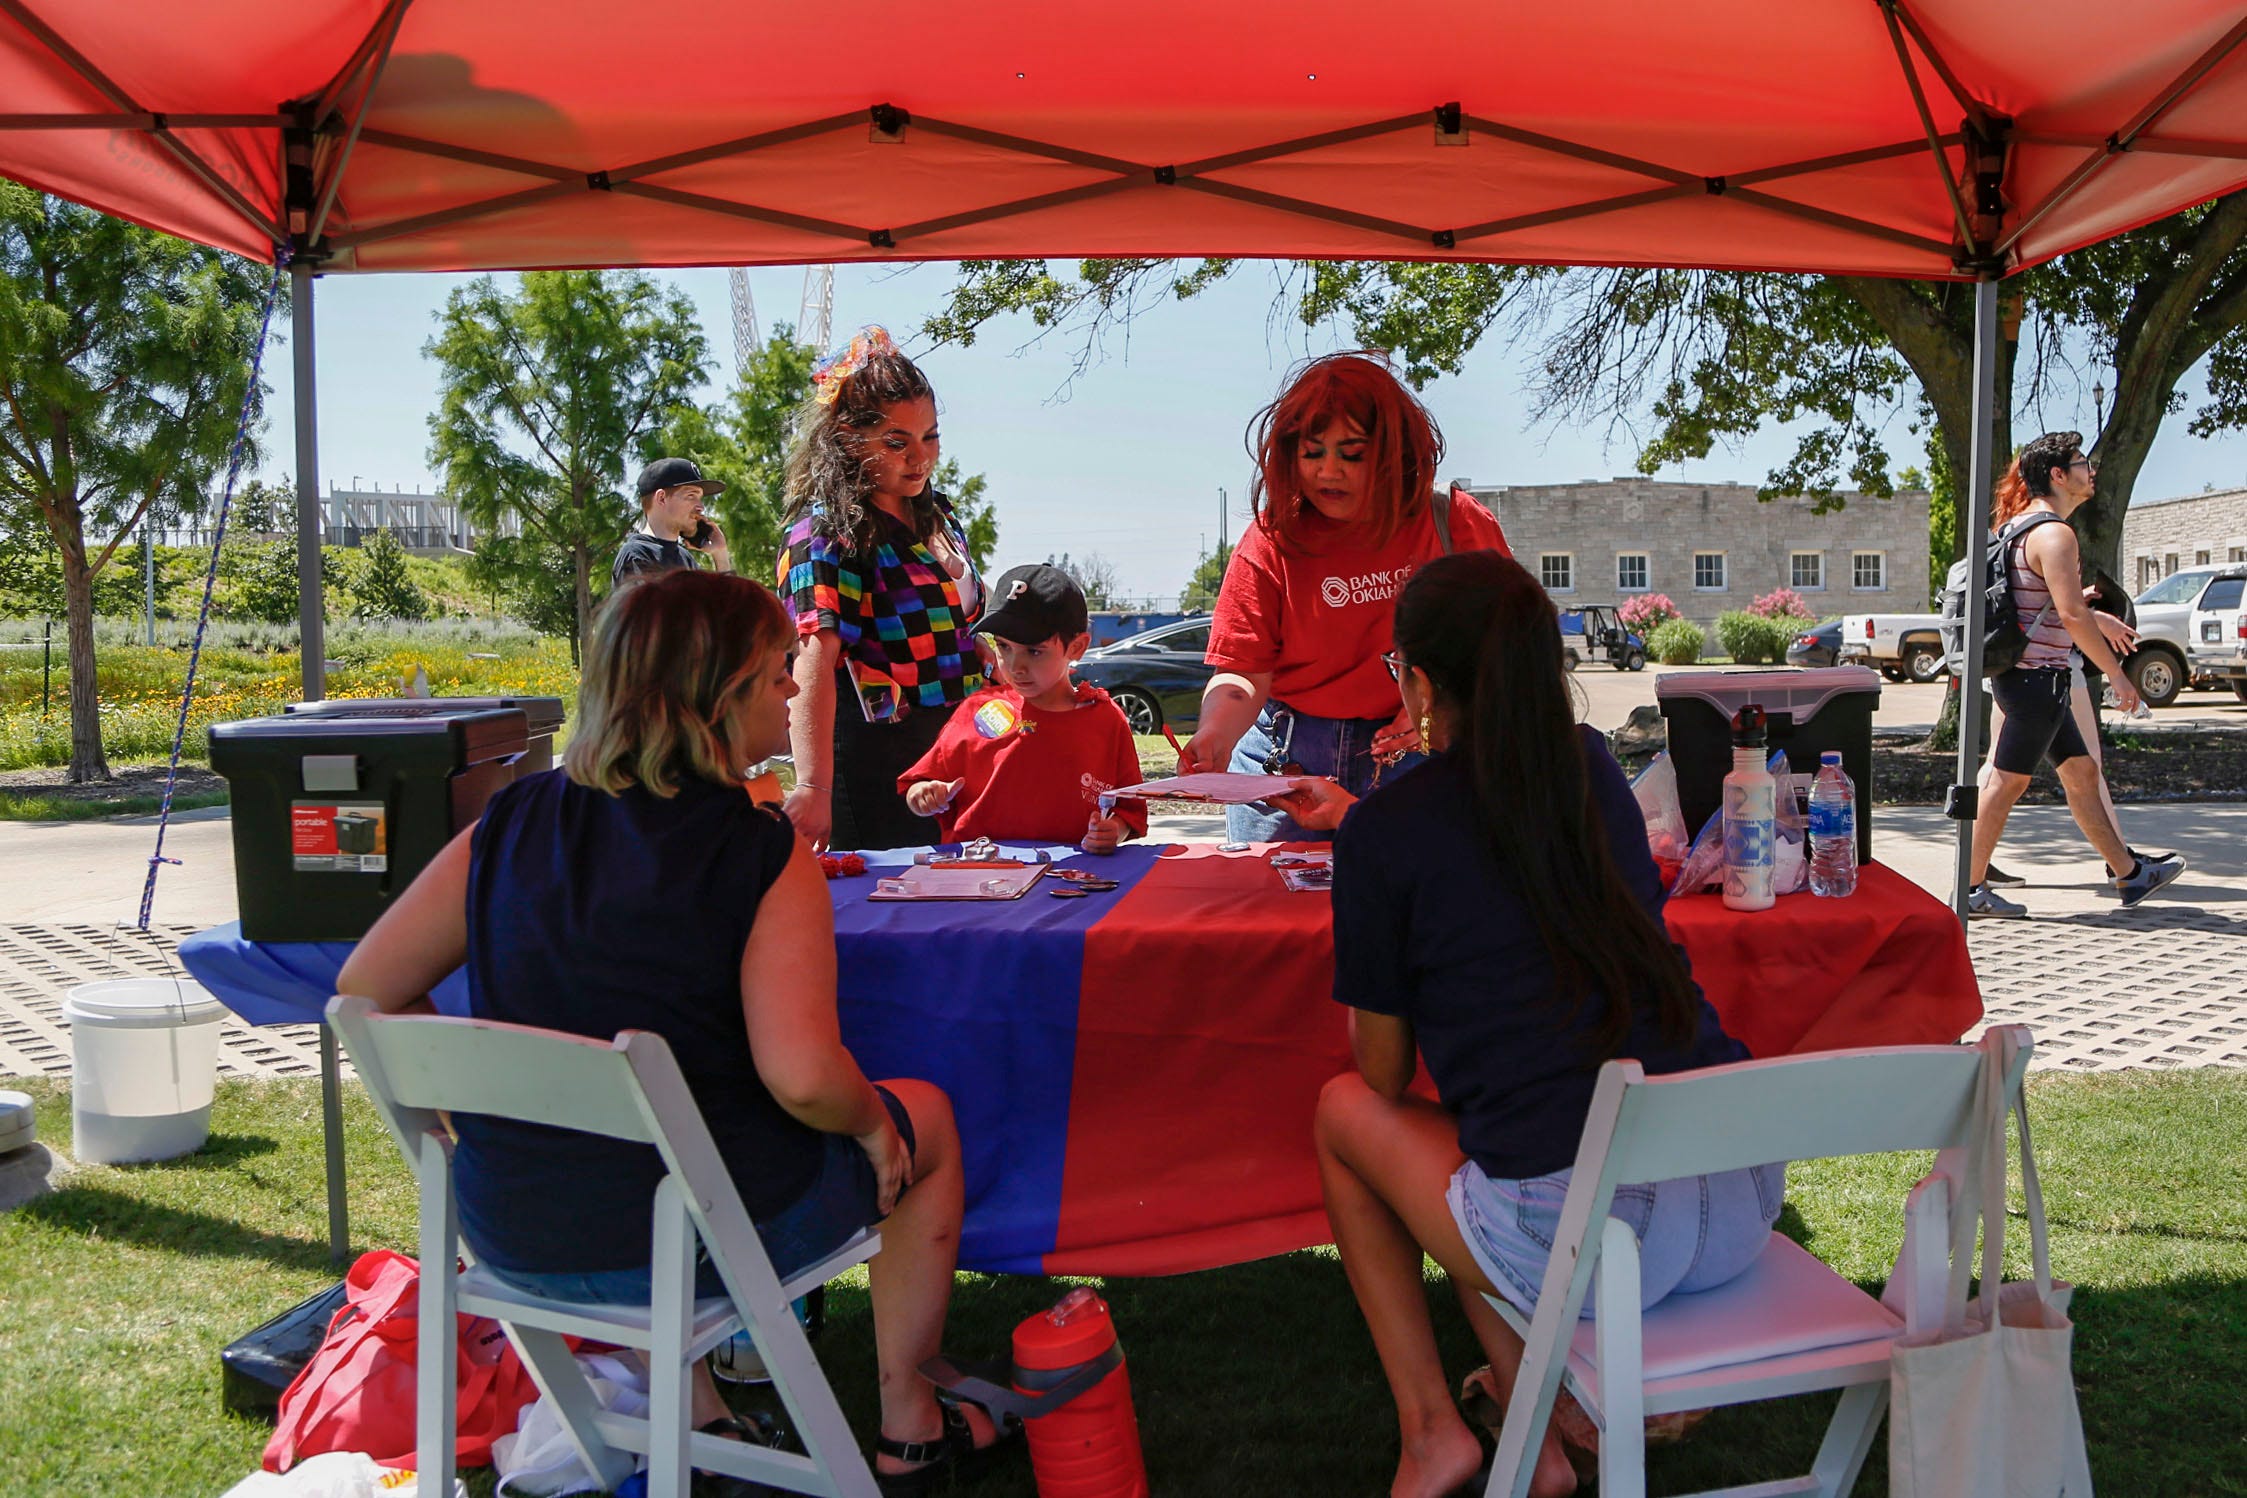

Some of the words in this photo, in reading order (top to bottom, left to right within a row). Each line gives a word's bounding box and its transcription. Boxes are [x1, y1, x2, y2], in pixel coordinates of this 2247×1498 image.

[1006, 579, 1028, 600] P
[1350, 570, 1393, 591] BANK
[1394, 564, 1412, 582] OF
[1352, 580, 1407, 604] OKLAHO
